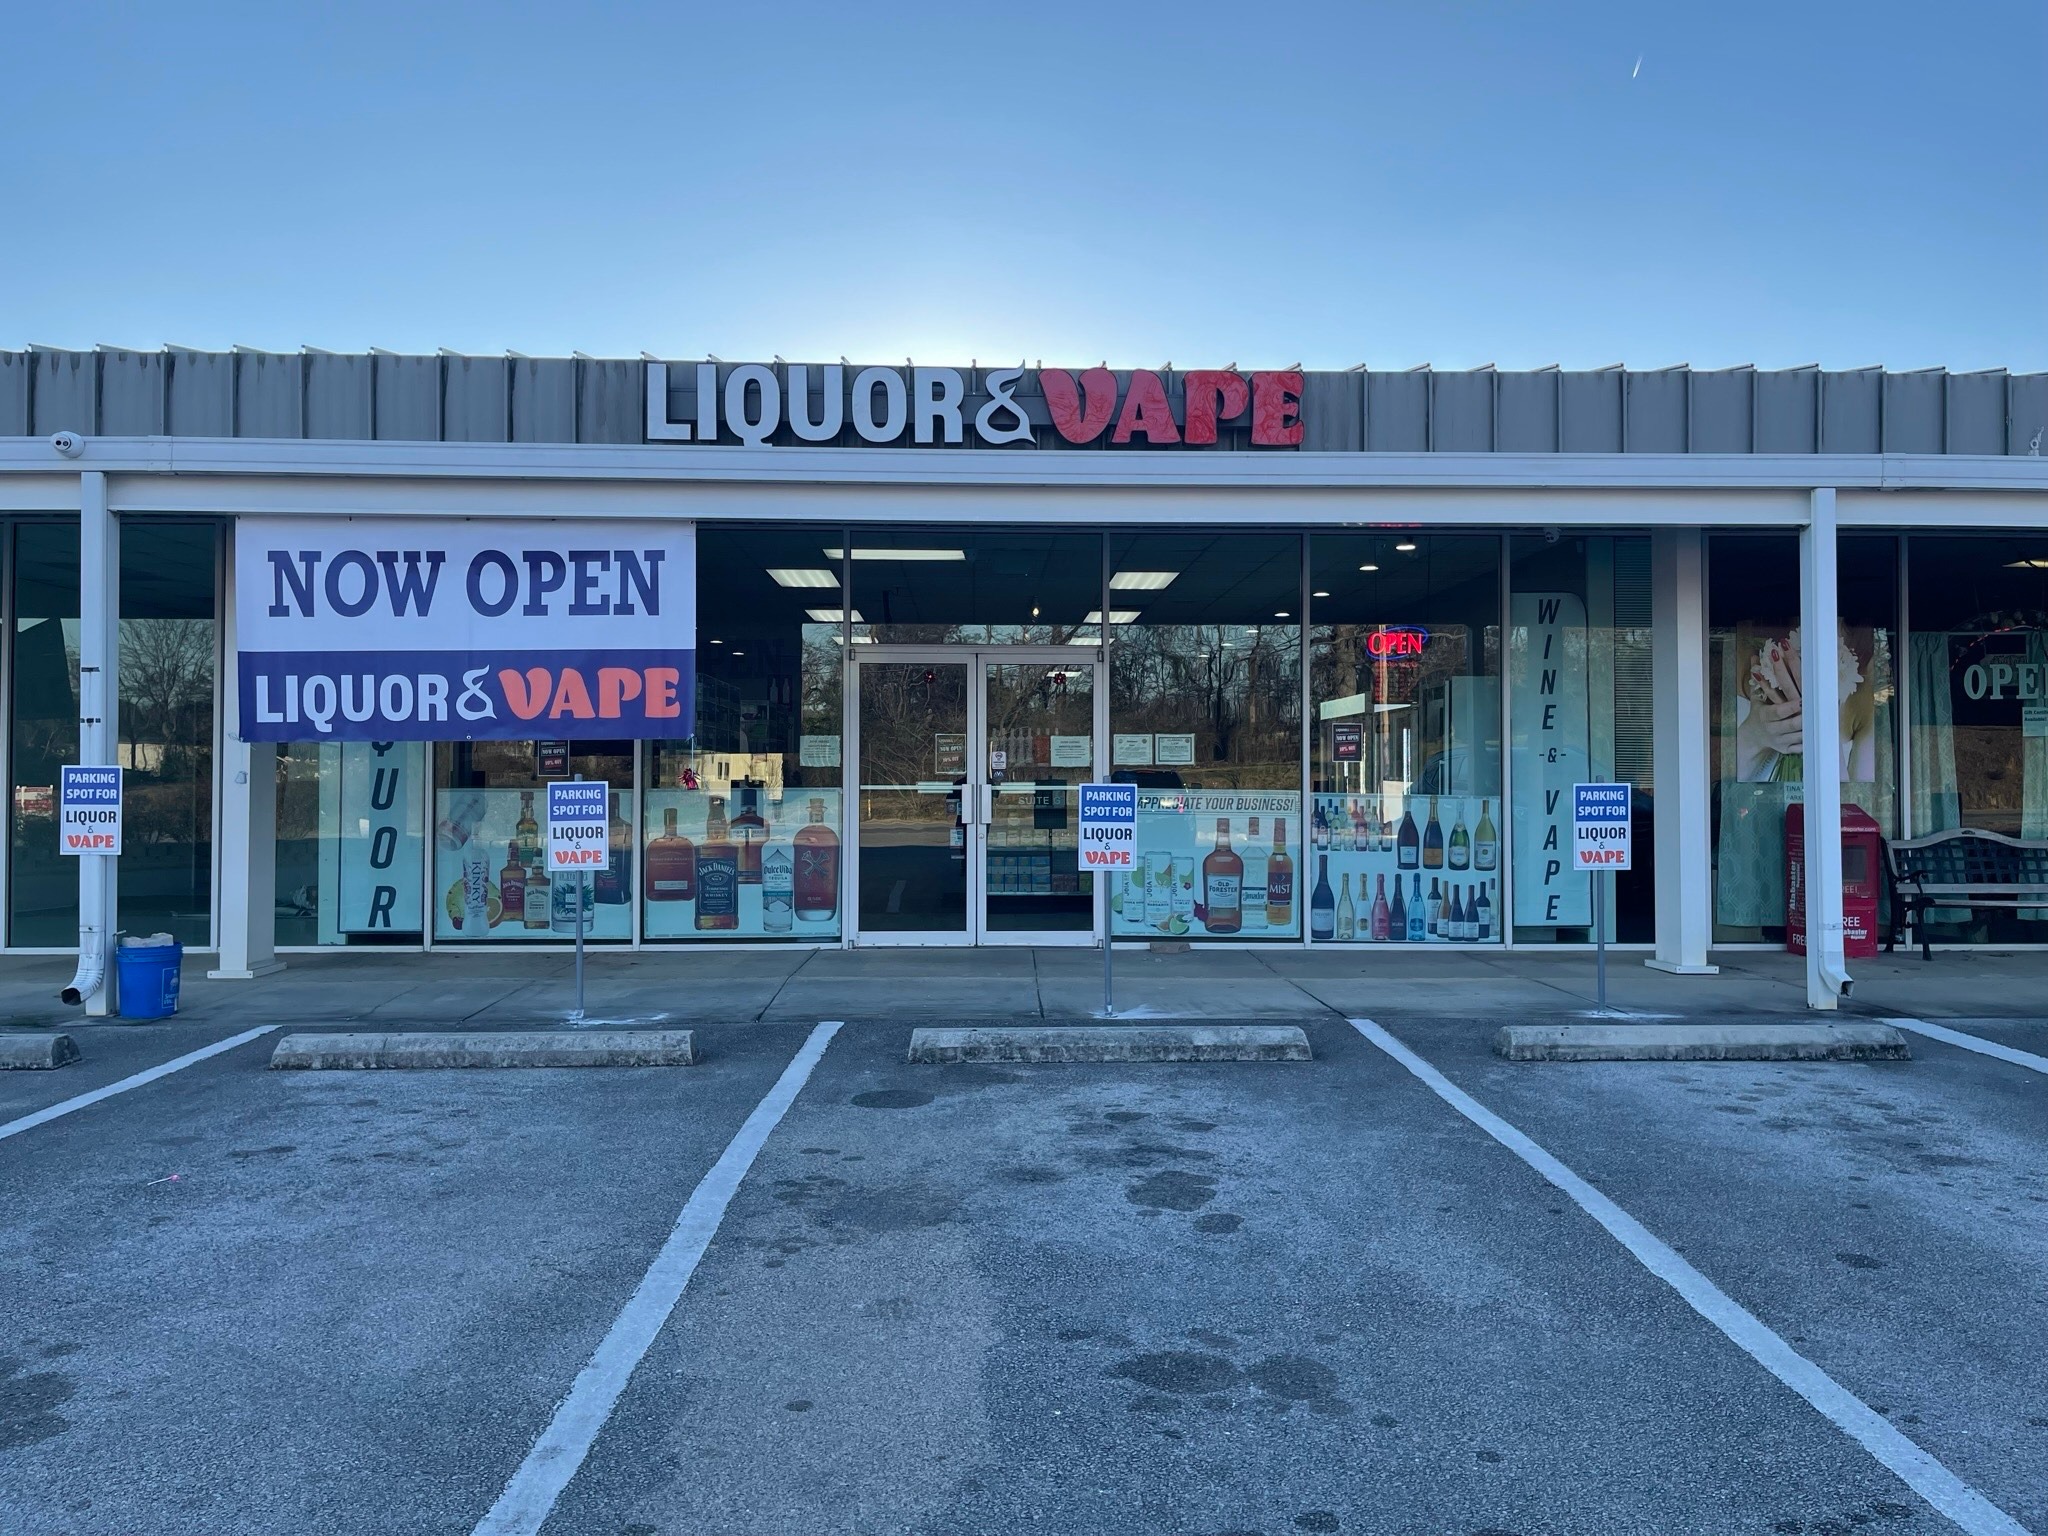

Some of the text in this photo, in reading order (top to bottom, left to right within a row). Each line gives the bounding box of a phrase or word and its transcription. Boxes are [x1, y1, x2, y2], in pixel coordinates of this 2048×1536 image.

[646, 358, 1305, 448] LIQUOR & VAPE
[267, 549, 666, 618] NOW OPEN
[1367, 632, 1423, 655] OPEN
[1538, 598, 1561, 730] WINE
[1963, 663, 2048, 700] OPE
[255, 664, 681, 733] LIQUOR & VAPE
[69, 773, 116, 784] PARKING
[66, 789, 117, 799] SPOT FOR
[554, 789, 602, 800] PARKING
[1018, 796, 1050, 805] SUITE
[1086, 791, 1131, 801] PARKING
[1580, 790, 1625, 801] PARKING
[553, 804, 603, 815] SPOT FOR
[1205, 796, 1234, 811] YOUR
[1235, 798, 1294, 811] BUSINESS!
[1084, 806, 1133, 817] SPOT FOR
[1578, 806, 1626, 816] SPOT FOR
[65, 811, 117, 826] LIQUOR
[67, 834, 115, 848] VAPE
[552, 826, 604, 842] LIQUOR
[1083, 827, 1133, 842] LIQUOR
[1578, 827, 1627, 841] LIQUOR
[554, 850, 603, 864] VAPE
[1084, 850, 1131, 864] VAPE
[1543, 789, 1560, 920] VAPE
[1579, 850, 1625, 864] VAPE
[698, 865, 713, 876] JACK
[472, 861, 482, 904] KINKY
[1208, 885, 1238, 893] FORESTER
[1269, 883, 1291, 894] MIST
[1789, 860, 1798, 910] Alabaster
